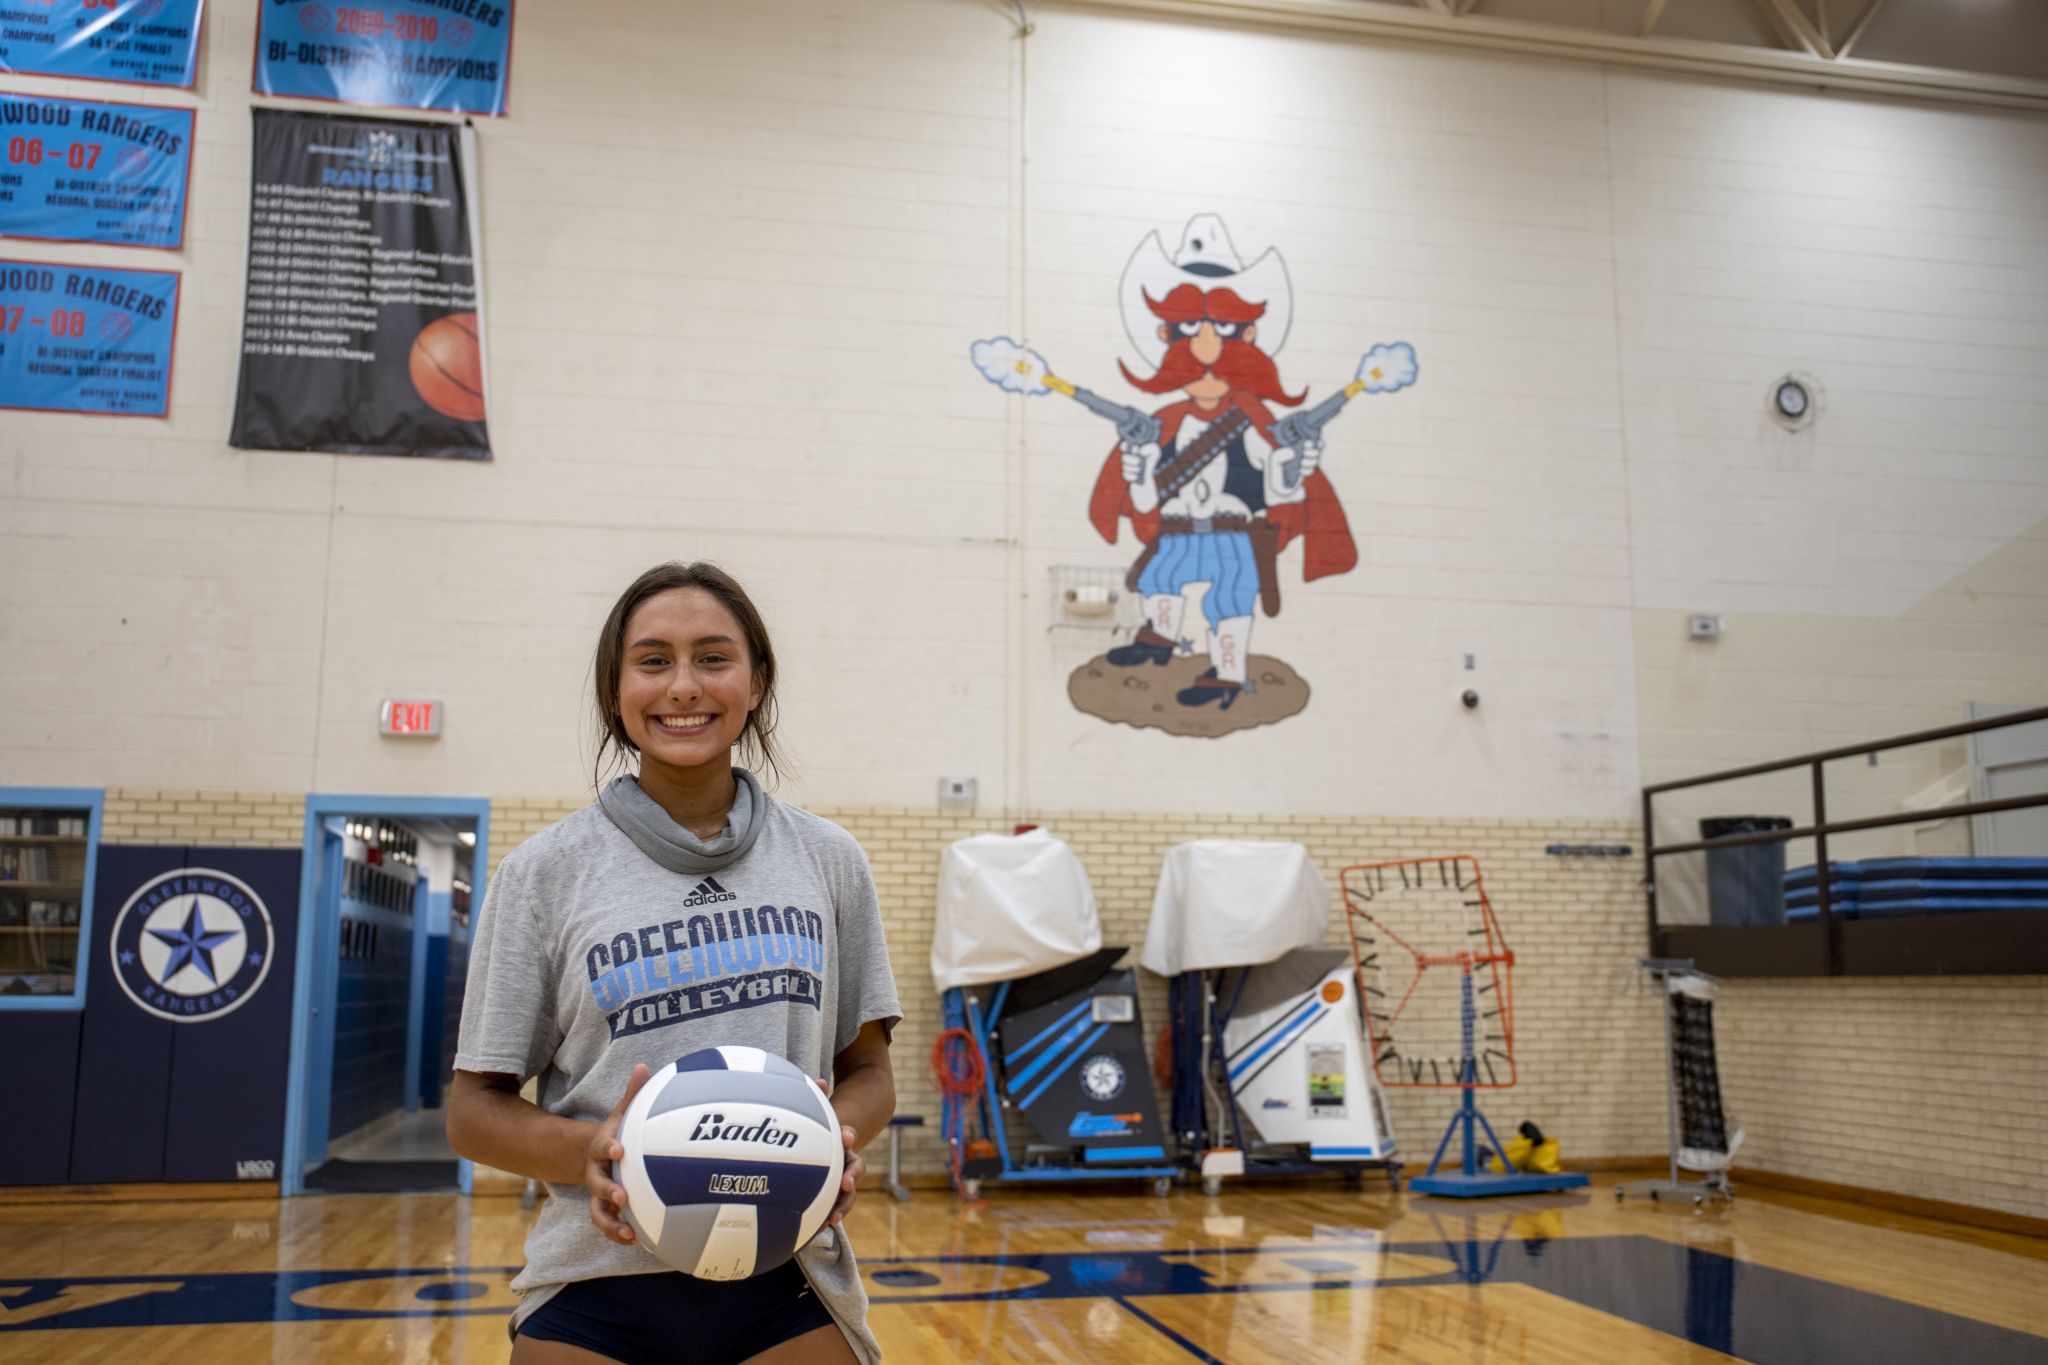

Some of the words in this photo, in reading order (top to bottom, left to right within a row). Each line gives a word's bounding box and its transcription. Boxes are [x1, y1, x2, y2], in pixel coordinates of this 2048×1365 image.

[0, 101, 71, 126] WOOD
[81, 108, 182, 156] RANGERS
[322, 168, 433, 192] RANGERS
[65, 274, 167, 320] RANGERS
[391, 703, 432, 731] EXIT
[138, 879, 253, 917] GREENWOOD
[683, 890, 736, 907] adidas
[586, 905, 824, 1012] GREENWOOD
[142, 985, 237, 1013] RANGERS
[689, 1113, 799, 1149] Baden
[709, 1173, 769, 1195] LEXUM
